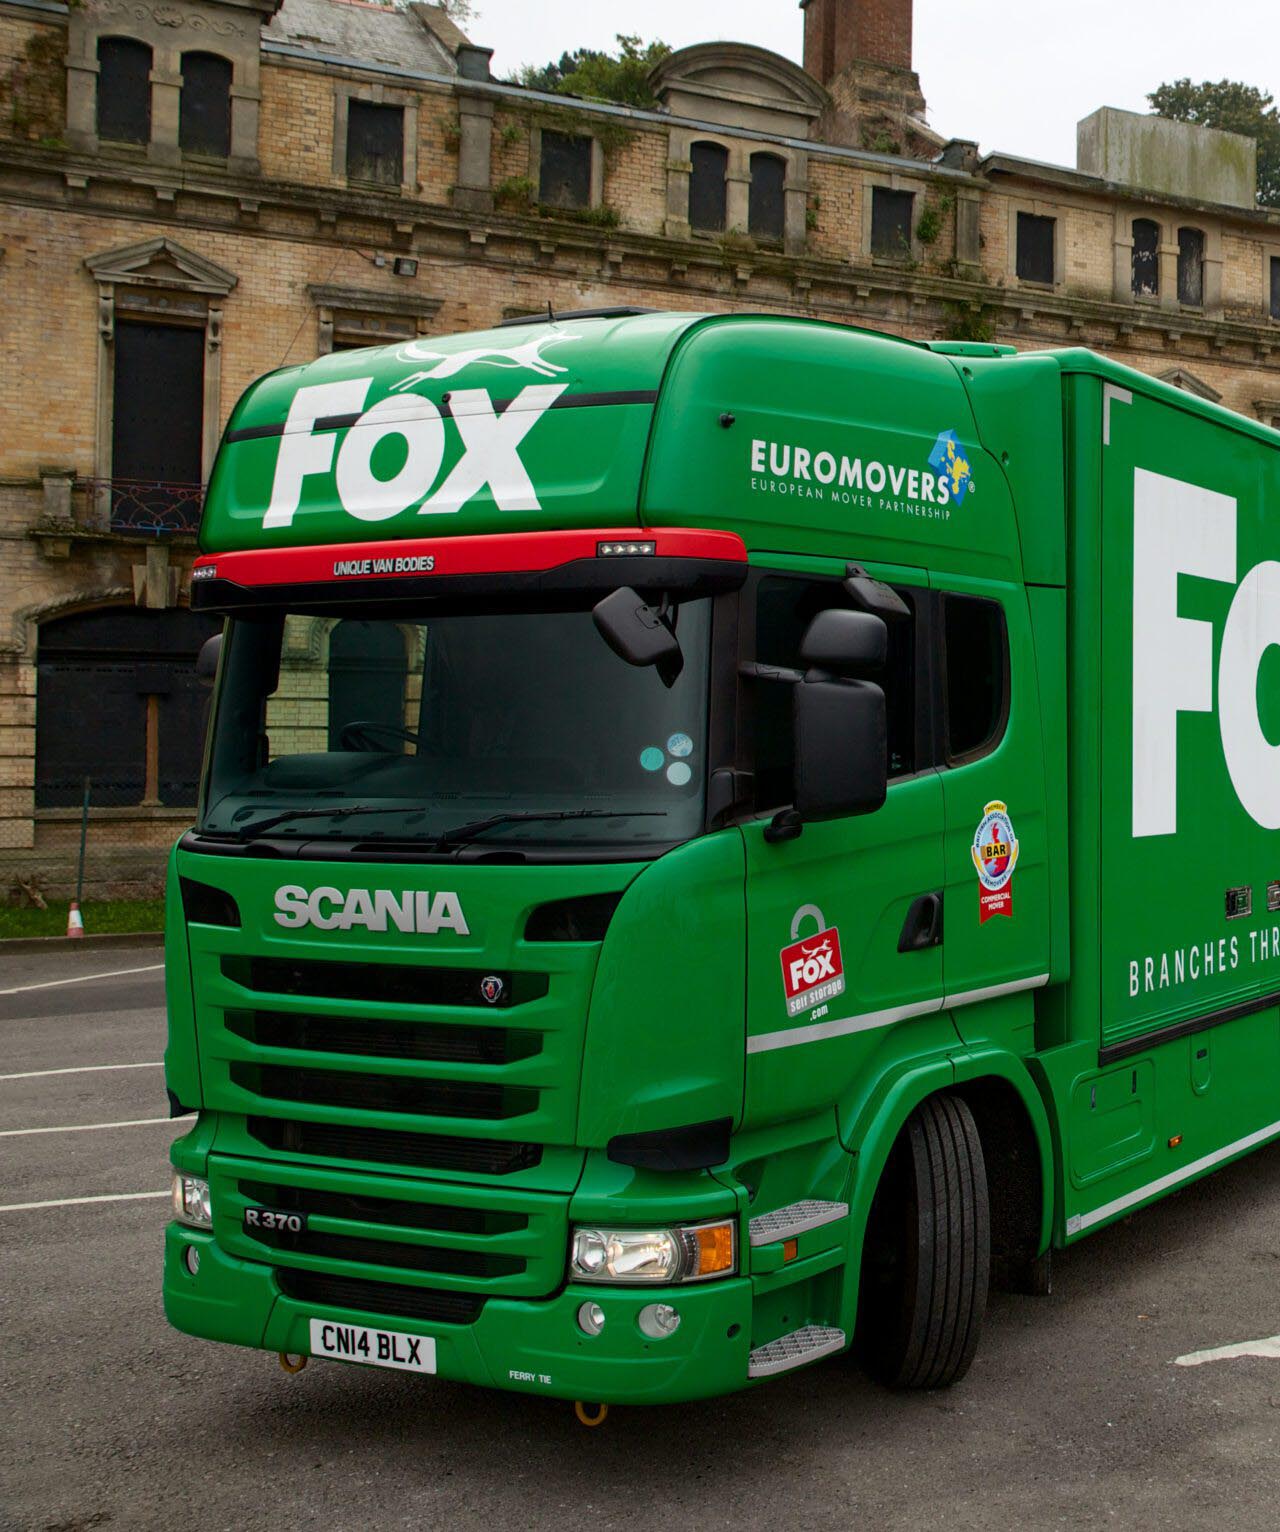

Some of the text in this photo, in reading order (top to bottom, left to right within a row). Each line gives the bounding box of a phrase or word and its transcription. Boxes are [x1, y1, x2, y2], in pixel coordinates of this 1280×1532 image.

[262, 376, 570, 529] FOX
[751, 439, 950, 505] EUROMOVERS
[751, 477, 951, 521] EUROPEAN MOVER PARTNERSHIP
[333, 555, 435, 576] UNIQUE VAN BODIES
[986, 844, 1007, 858] BAR
[273, 884, 470, 936] SCANIA
[981, 892, 1011, 904] COMMERCIAL
[988, 901, 1005, 911] MOVER
[790, 949, 836, 992] FOX
[1129, 936, 1239, 997] BRANCHES
[810, 1004, 829, 1022] .com
[246, 1209, 302, 1233] R 370
[321, 1325, 421, 1365] CN14 BLX
[509, 1370, 552, 1385] FERRY TIE
